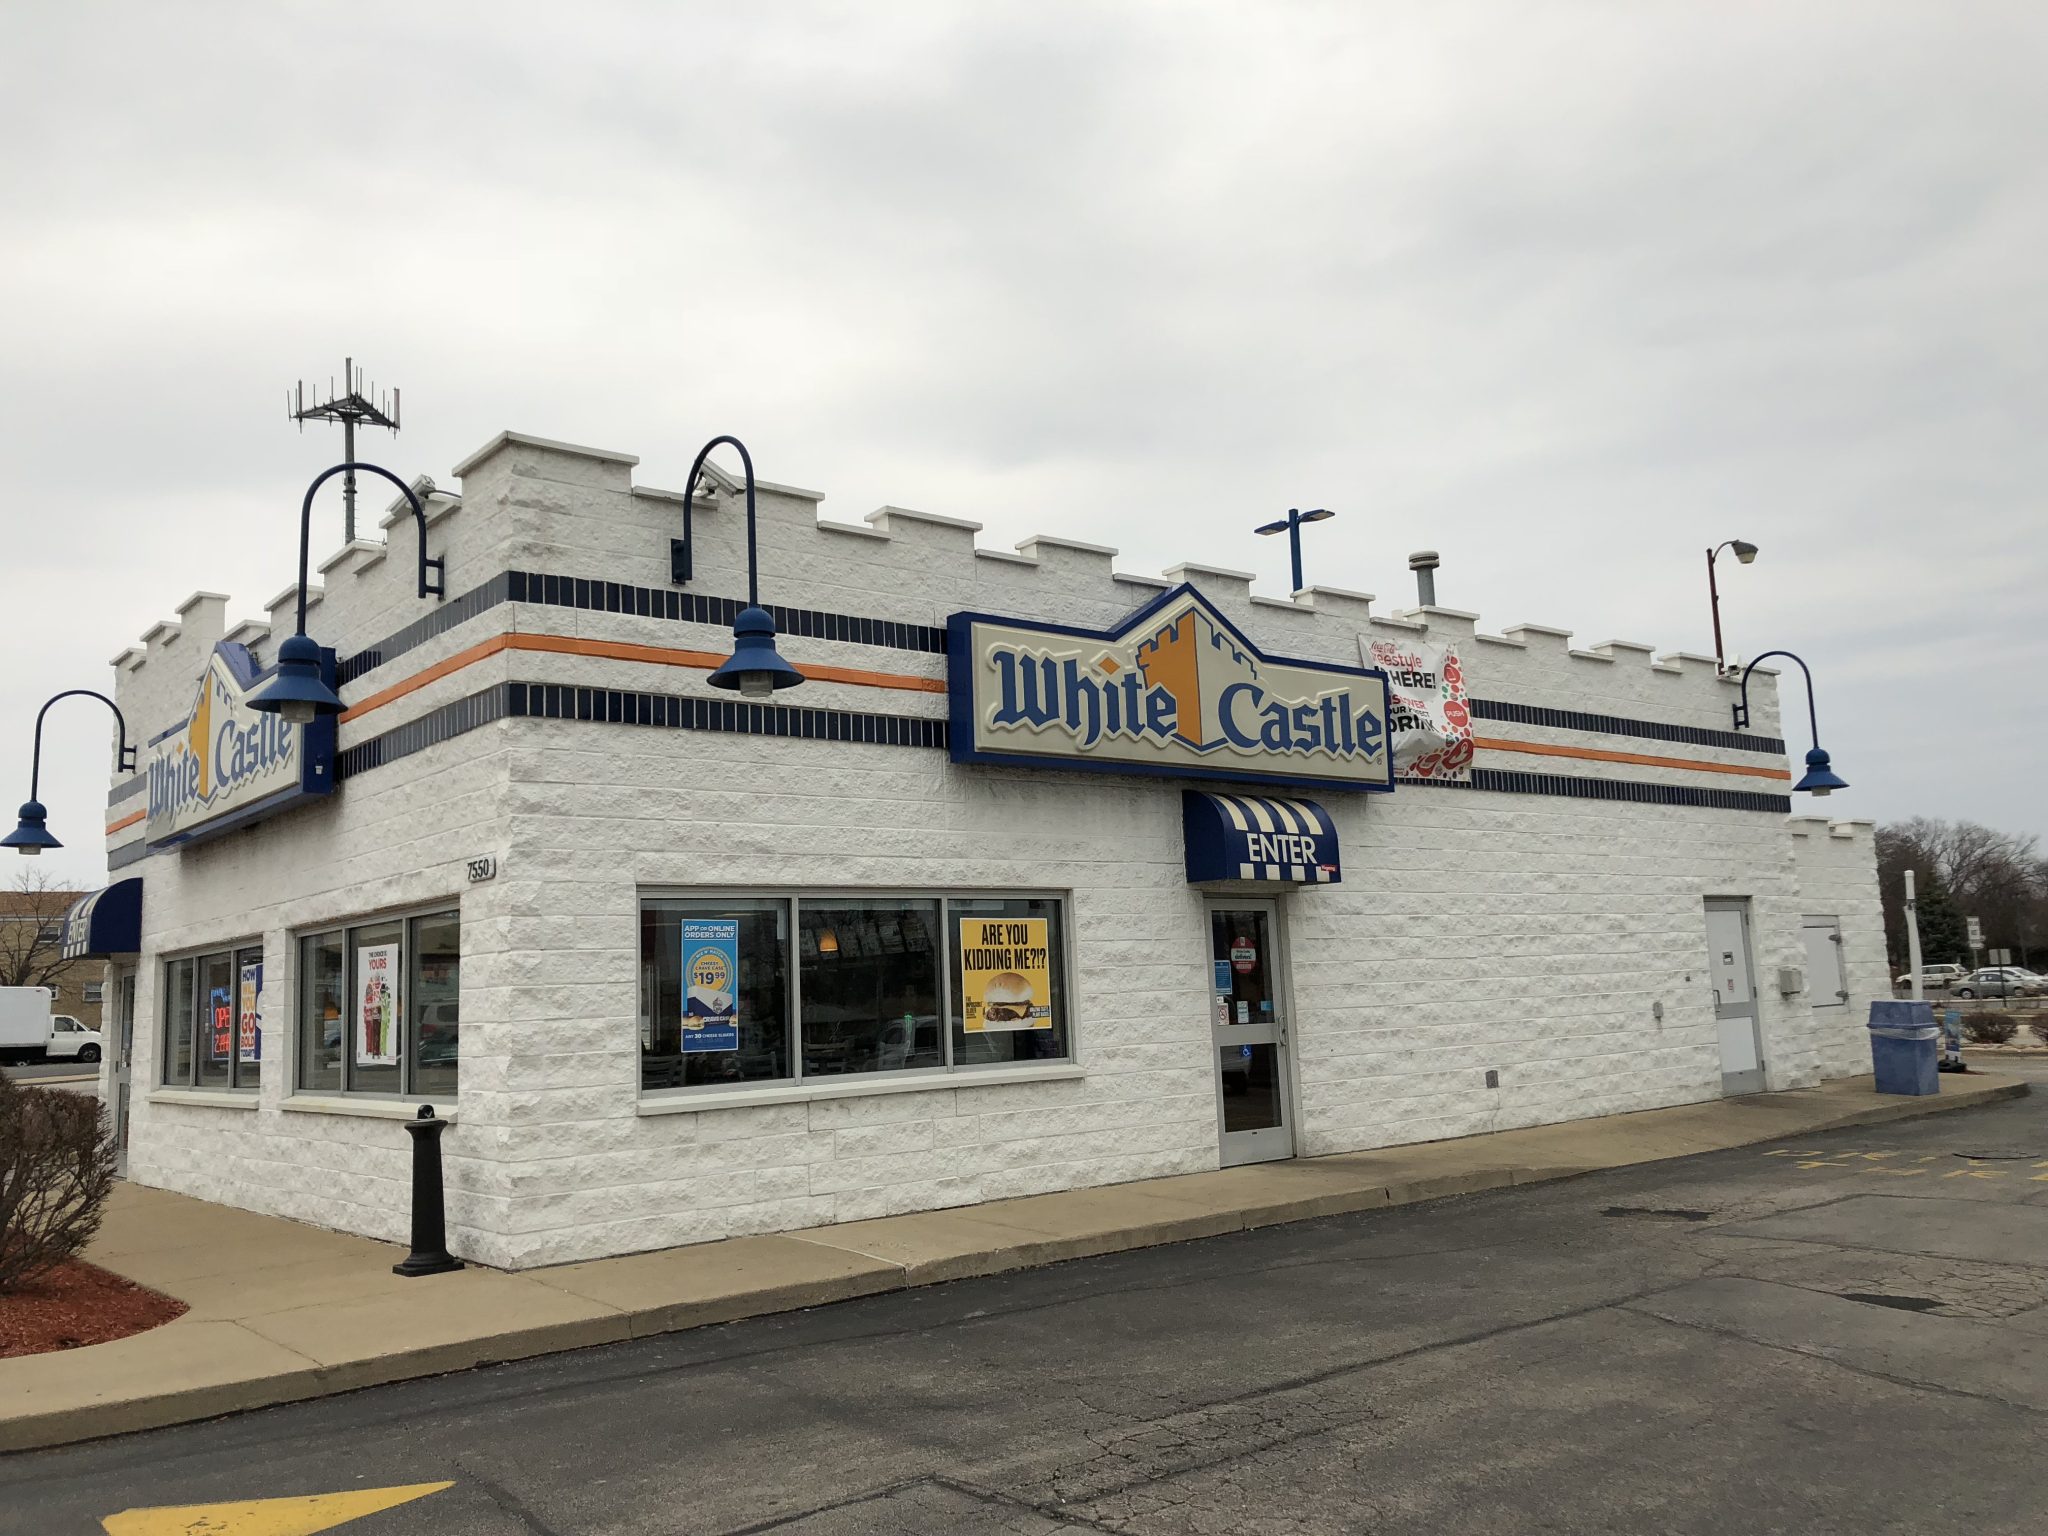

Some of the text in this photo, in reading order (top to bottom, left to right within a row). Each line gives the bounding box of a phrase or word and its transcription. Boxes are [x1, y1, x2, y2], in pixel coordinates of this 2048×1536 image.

[1389, 670, 1437, 690] HERE!
[992, 651, 1383, 758] White Castle
[148, 710, 293, 823] White Castle
[1246, 832, 1318, 865] ENTER
[467, 858, 490, 881] 7550
[981, 923, 1029, 946] ARE YOU
[368, 957, 387, 970] YOURS
[964, 947, 1047, 971] KIDDING ME?!?
[243, 967, 256, 982] HOW
[242, 997, 255, 1012] YOU
[214, 1006, 232, 1029] OPE
[241, 1012, 255, 1034] GO
[240, 1035, 255, 1049] BOLD
